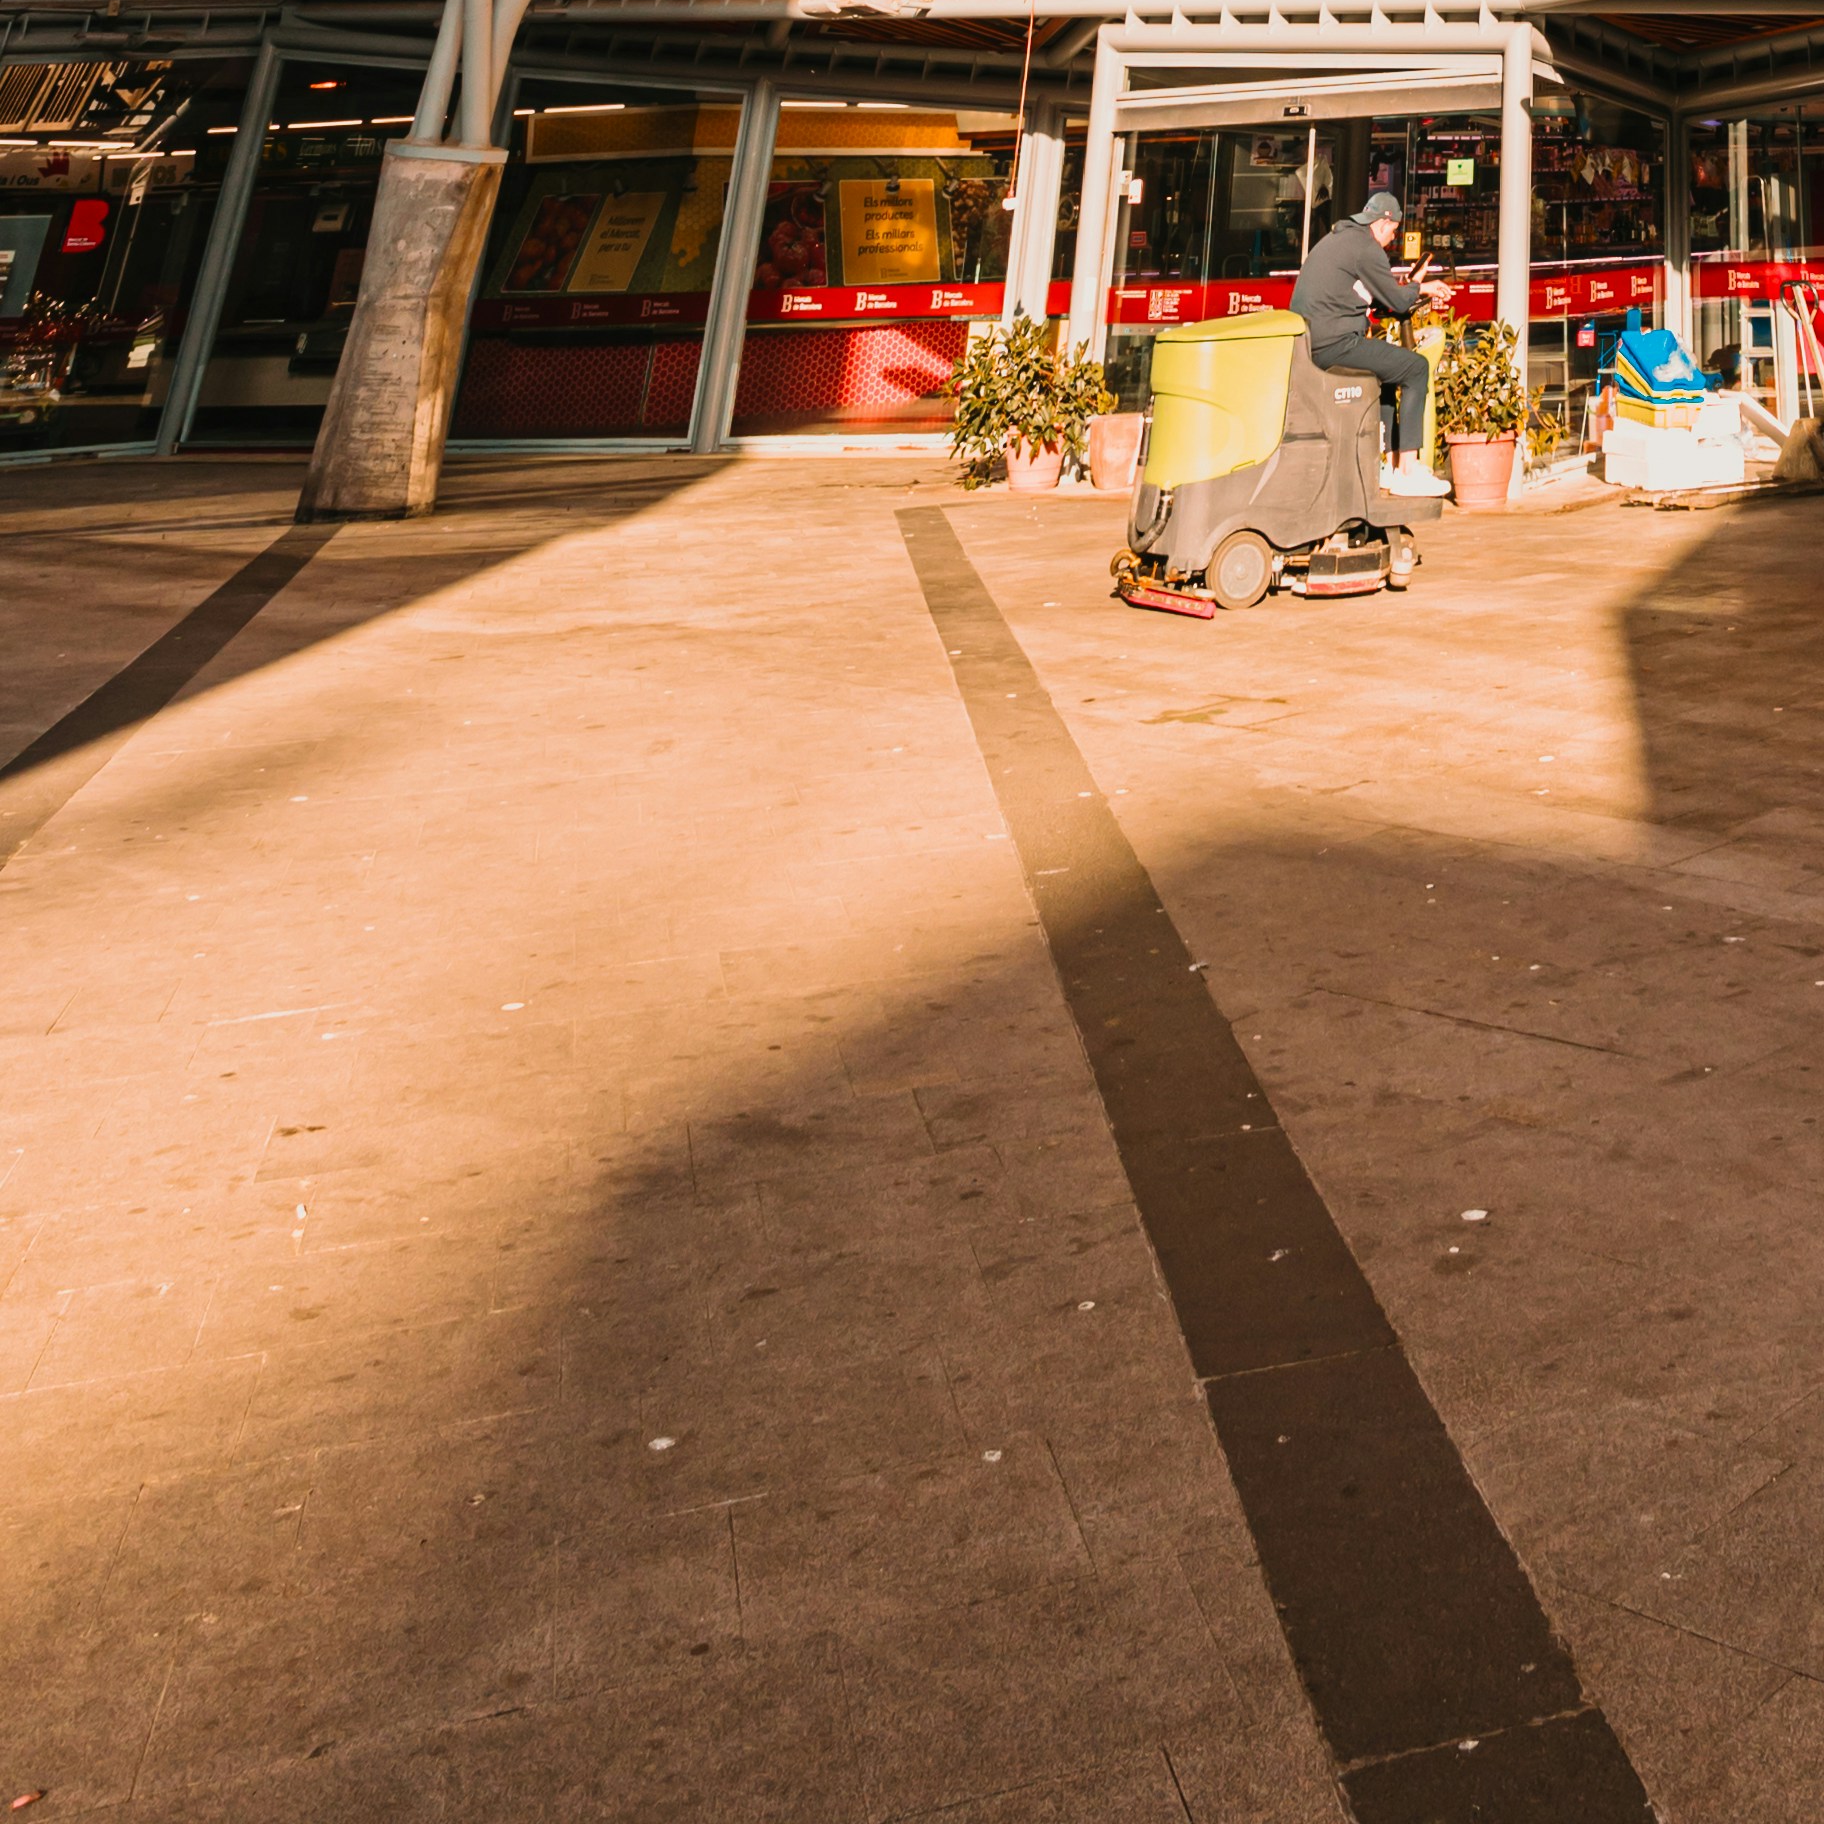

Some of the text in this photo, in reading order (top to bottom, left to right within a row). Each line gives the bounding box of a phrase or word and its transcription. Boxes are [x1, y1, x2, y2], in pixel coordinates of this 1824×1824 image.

[864, 196, 878, 207] Els
[864, 210, 913, 222] productes
[866, 228, 914, 240] Els millors
[858, 241, 923, 256] professionals
